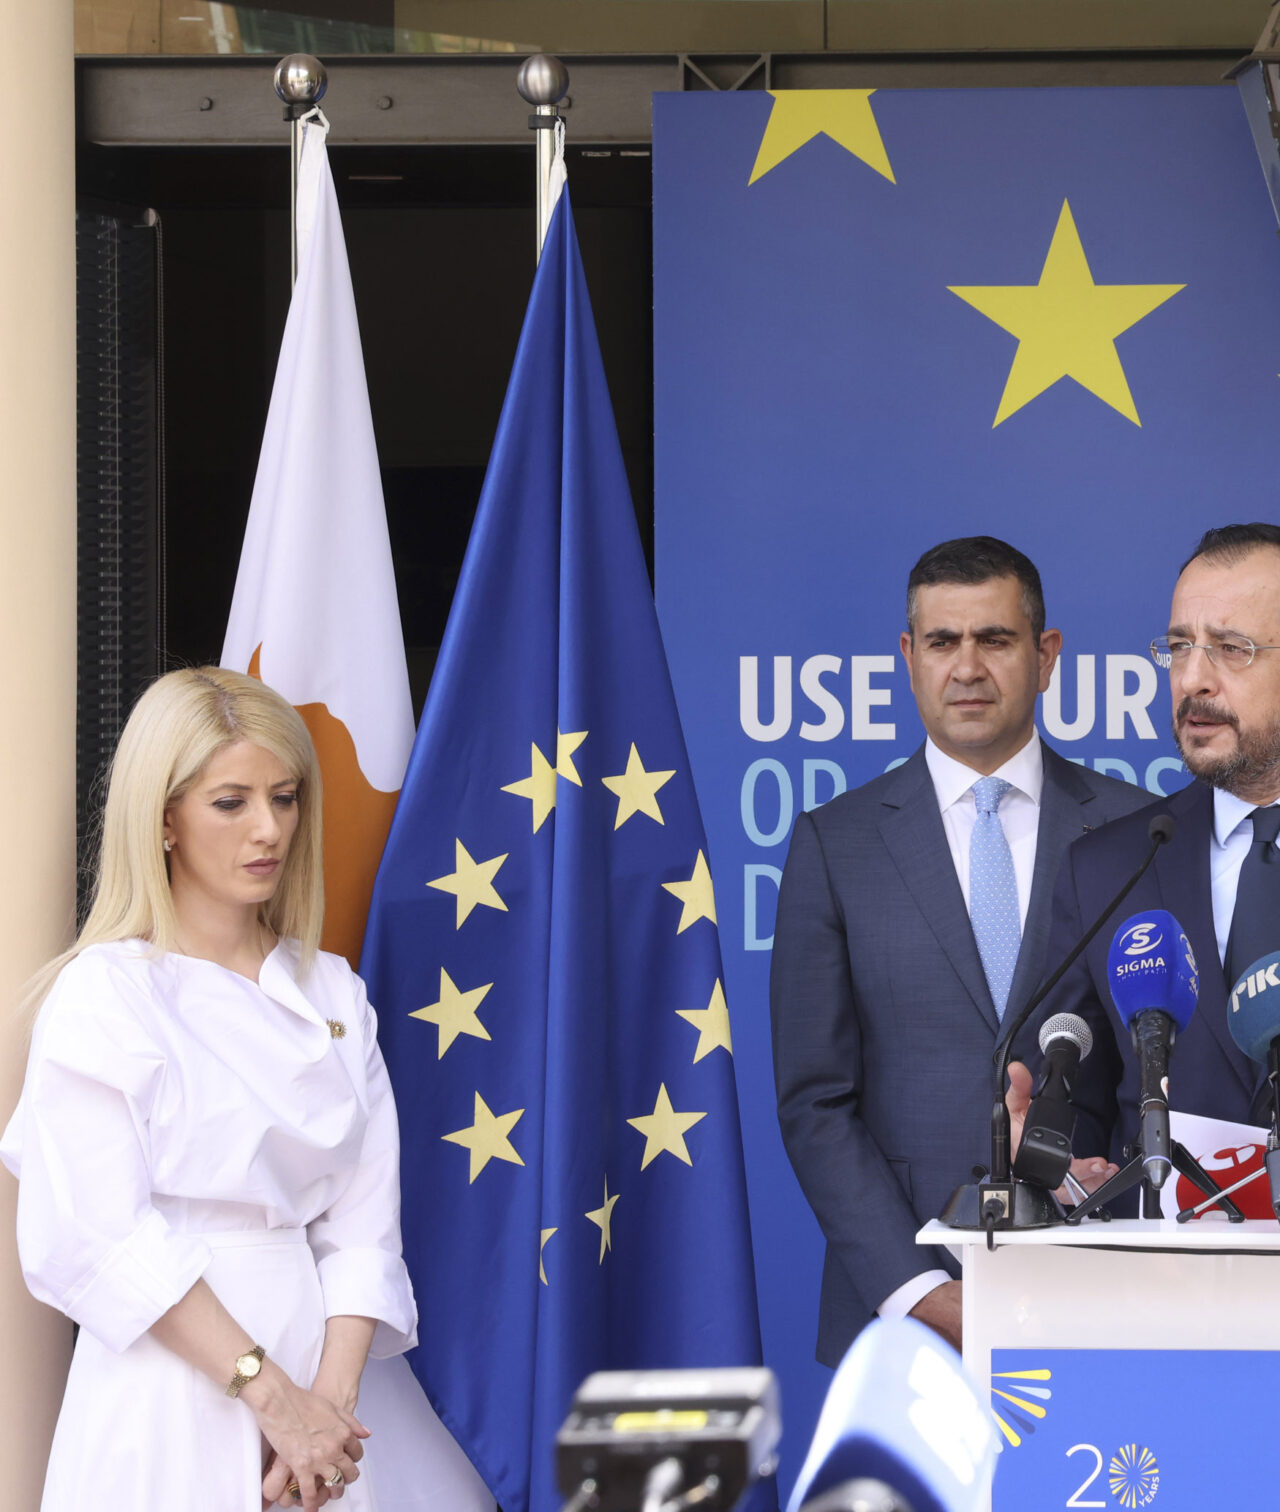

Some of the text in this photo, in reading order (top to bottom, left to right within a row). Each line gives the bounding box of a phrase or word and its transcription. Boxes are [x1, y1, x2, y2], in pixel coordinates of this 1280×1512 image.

[739, 654, 896, 742] USE
[1042, 654, 1158, 741] UR
[1116, 956, 1166, 977] SIGMA
[1138, 1476, 1160, 1508] YEARS
